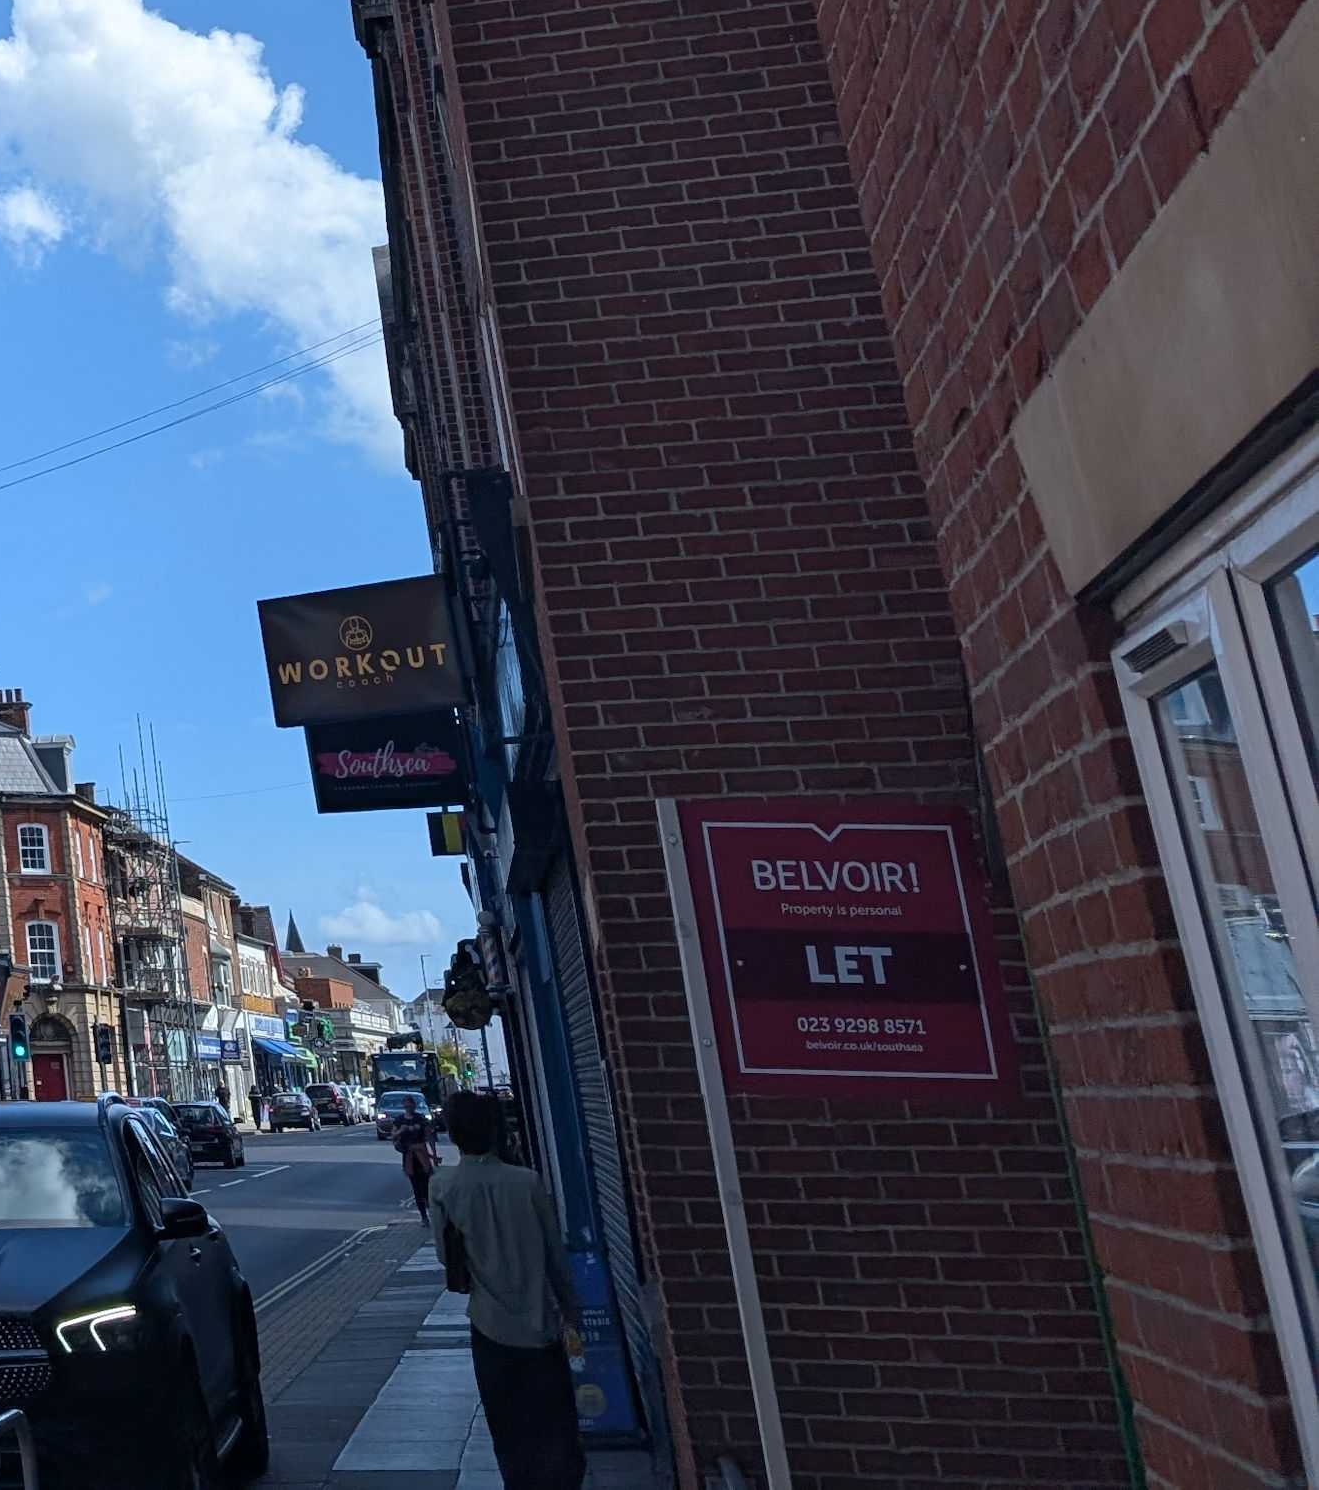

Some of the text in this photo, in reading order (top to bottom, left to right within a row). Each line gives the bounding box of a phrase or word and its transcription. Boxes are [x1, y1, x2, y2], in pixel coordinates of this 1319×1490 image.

[279, 643, 446, 684] WORKOUT
[336, 673, 394, 689] coach
[335, 740, 430, 779] Southsea
[751, 859, 920, 893] BELVOIR!
[781, 903, 902, 918] Property is personal
[805, 945, 893, 985] LET
[797, 1017, 926, 1035] 023 9298 8571
[806, 1040, 924, 1053] belvoir.co.uk/southsea
